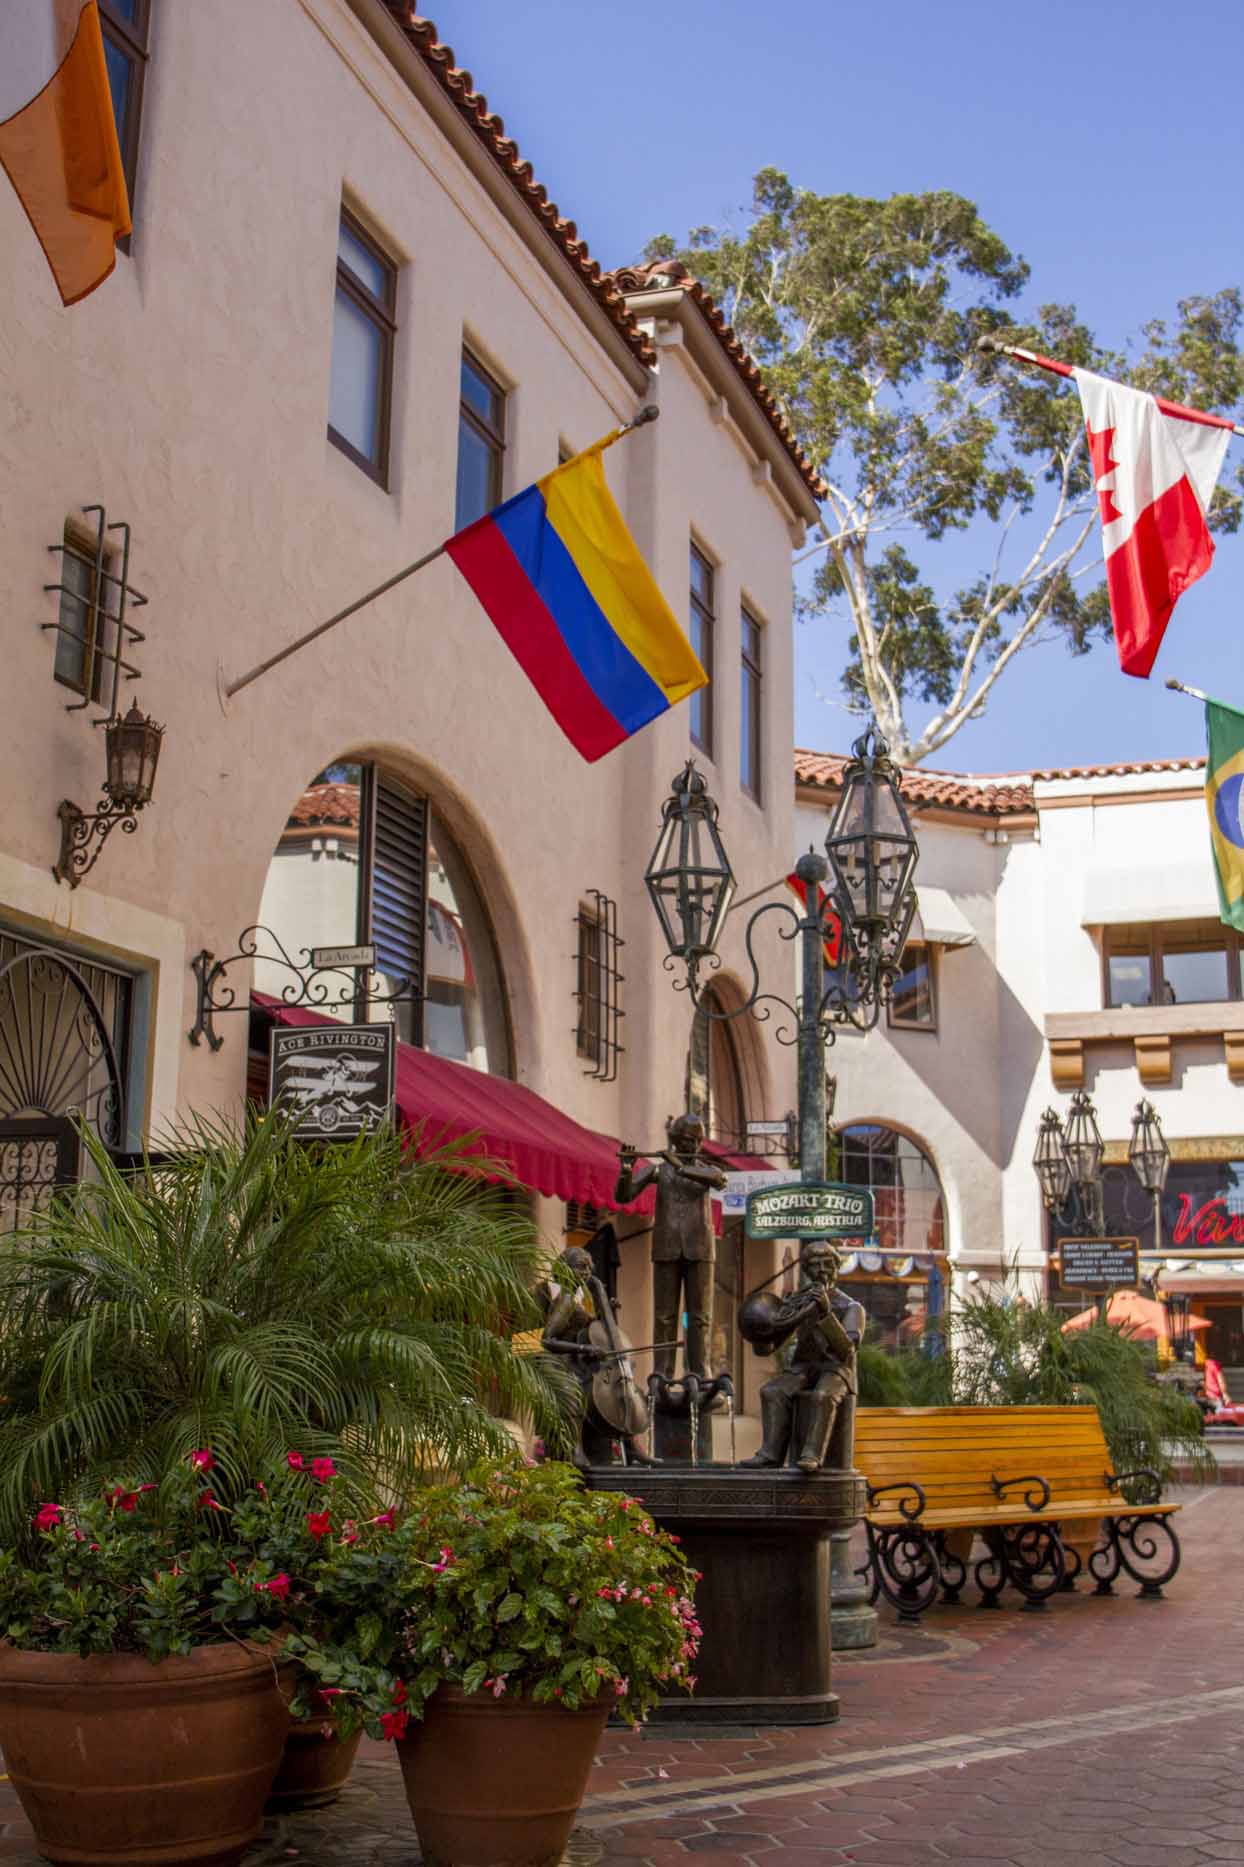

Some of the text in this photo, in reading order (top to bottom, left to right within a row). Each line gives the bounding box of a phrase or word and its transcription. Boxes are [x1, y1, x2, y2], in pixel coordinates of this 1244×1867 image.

[278, 1034, 386, 1053] ACE RIVINGTON
[756, 1194, 864, 1215] MOZART TRIO
[755, 1215, 863, 1227] SALZBURG, AUSTRIA
